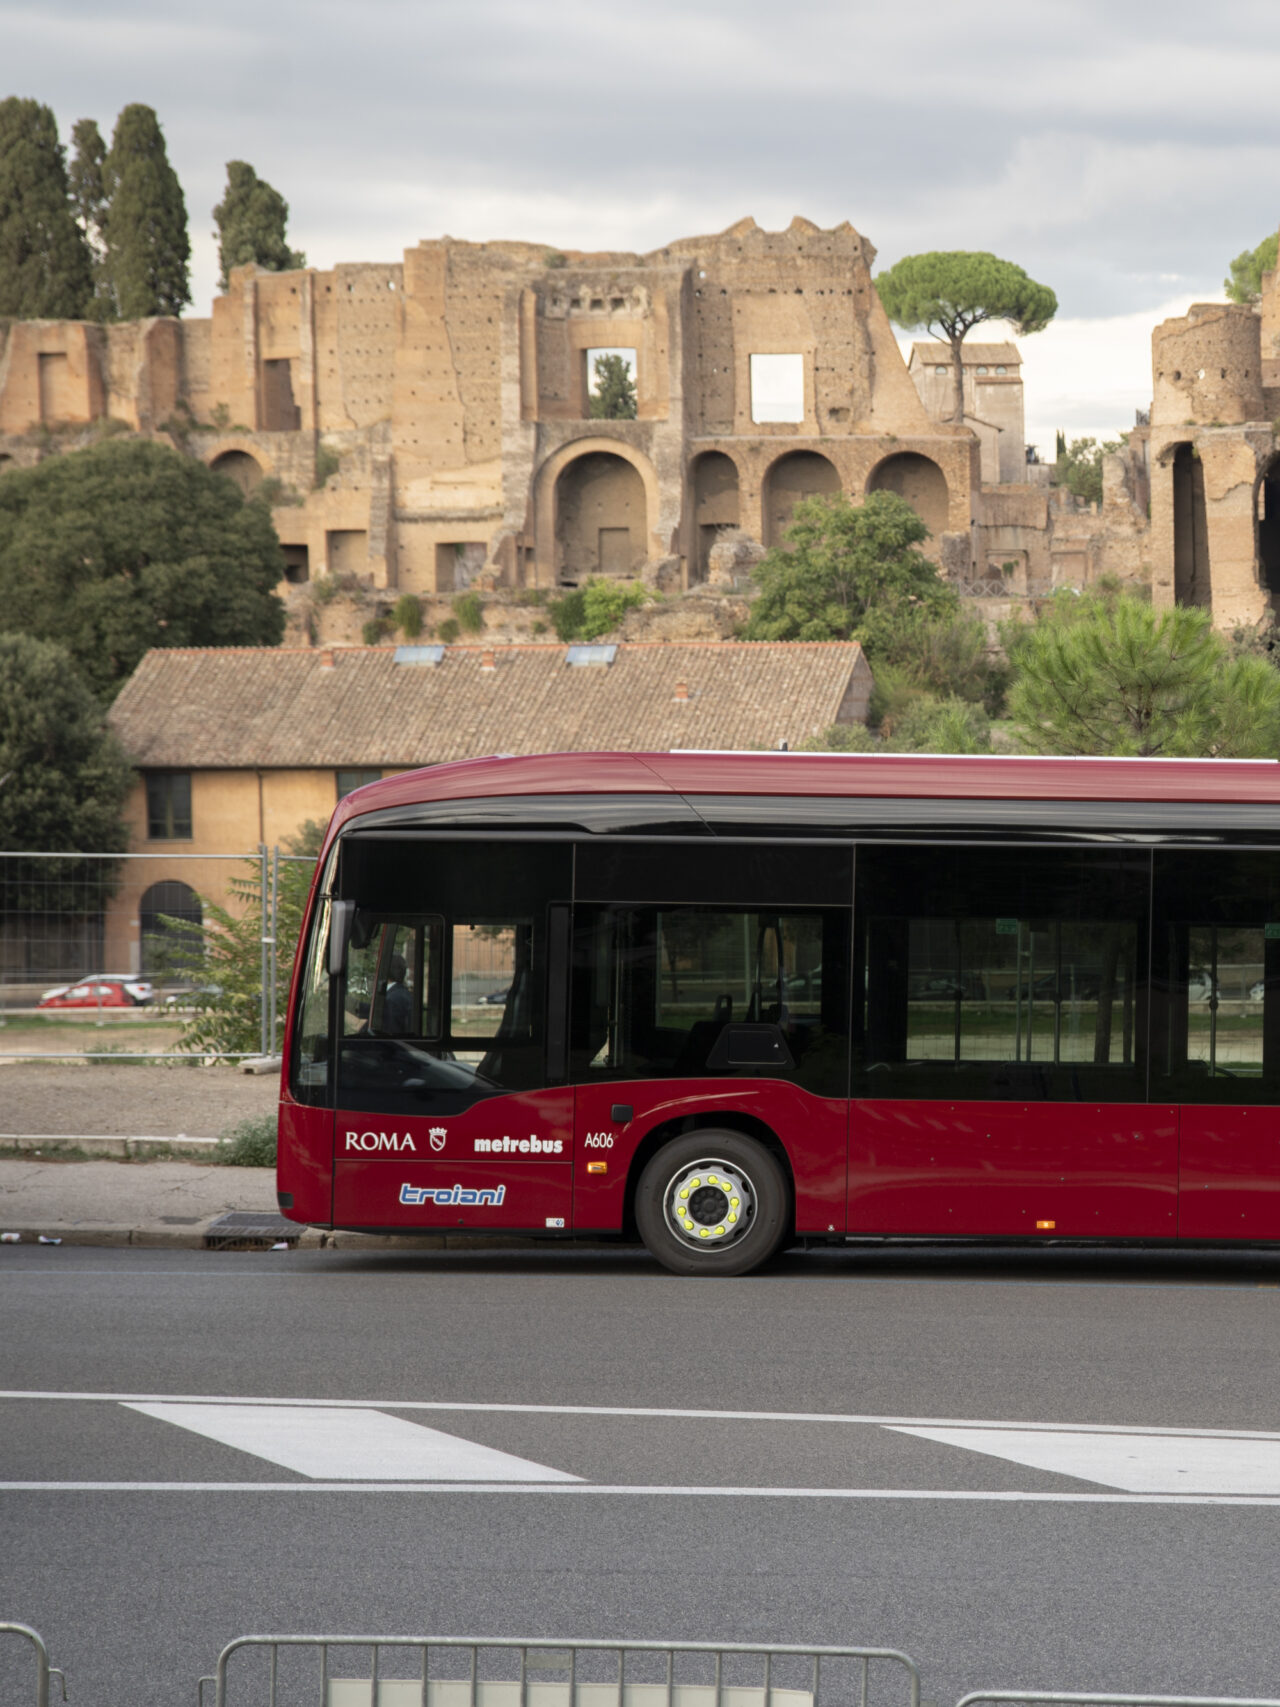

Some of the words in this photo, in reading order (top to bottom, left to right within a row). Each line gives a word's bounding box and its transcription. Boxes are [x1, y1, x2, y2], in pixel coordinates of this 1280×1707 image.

[345, 1131, 417, 1152] ROMA
[473, 1134, 563, 1153] metrebus
[584, 1131, 614, 1149] A606
[399, 1182, 506, 1207] troiani
